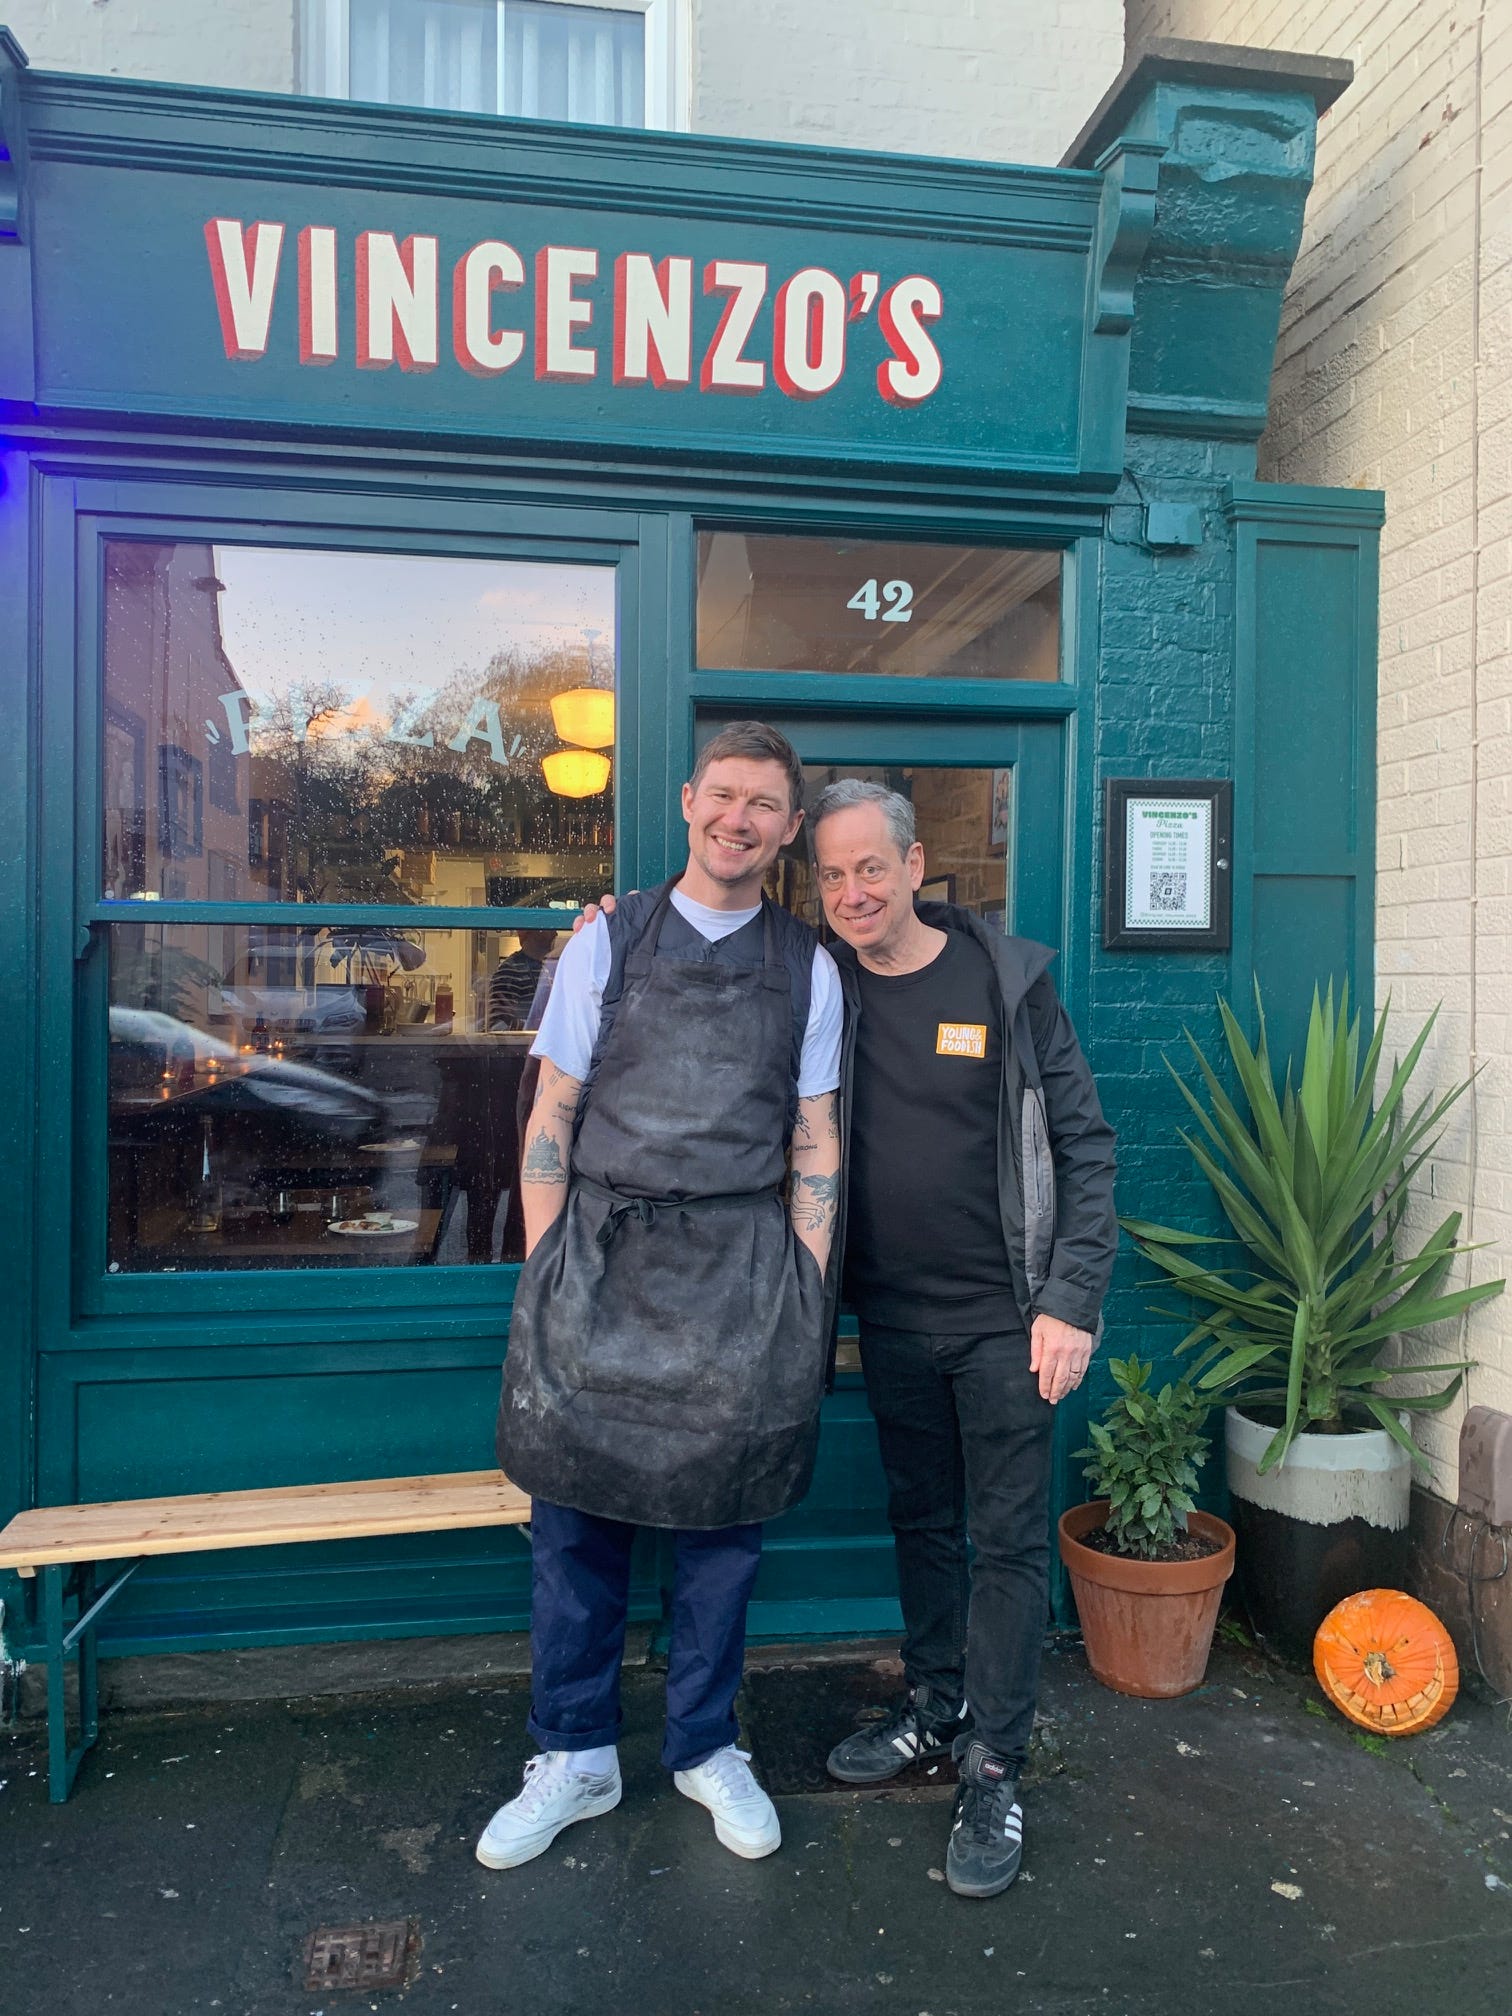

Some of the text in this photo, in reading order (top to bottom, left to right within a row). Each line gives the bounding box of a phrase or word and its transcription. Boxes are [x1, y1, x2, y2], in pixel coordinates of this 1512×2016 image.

[204, 217, 943, 408] VINCENZO'S
[846, 578, 914, 622] 42
[1142, 811, 1197, 819] VINCENZO'S
[1156, 820, 1183, 829] Pizza
[1150, 831, 1188, 839] OPENING TIMES
[941, 1039, 982, 1054] FOODISH
